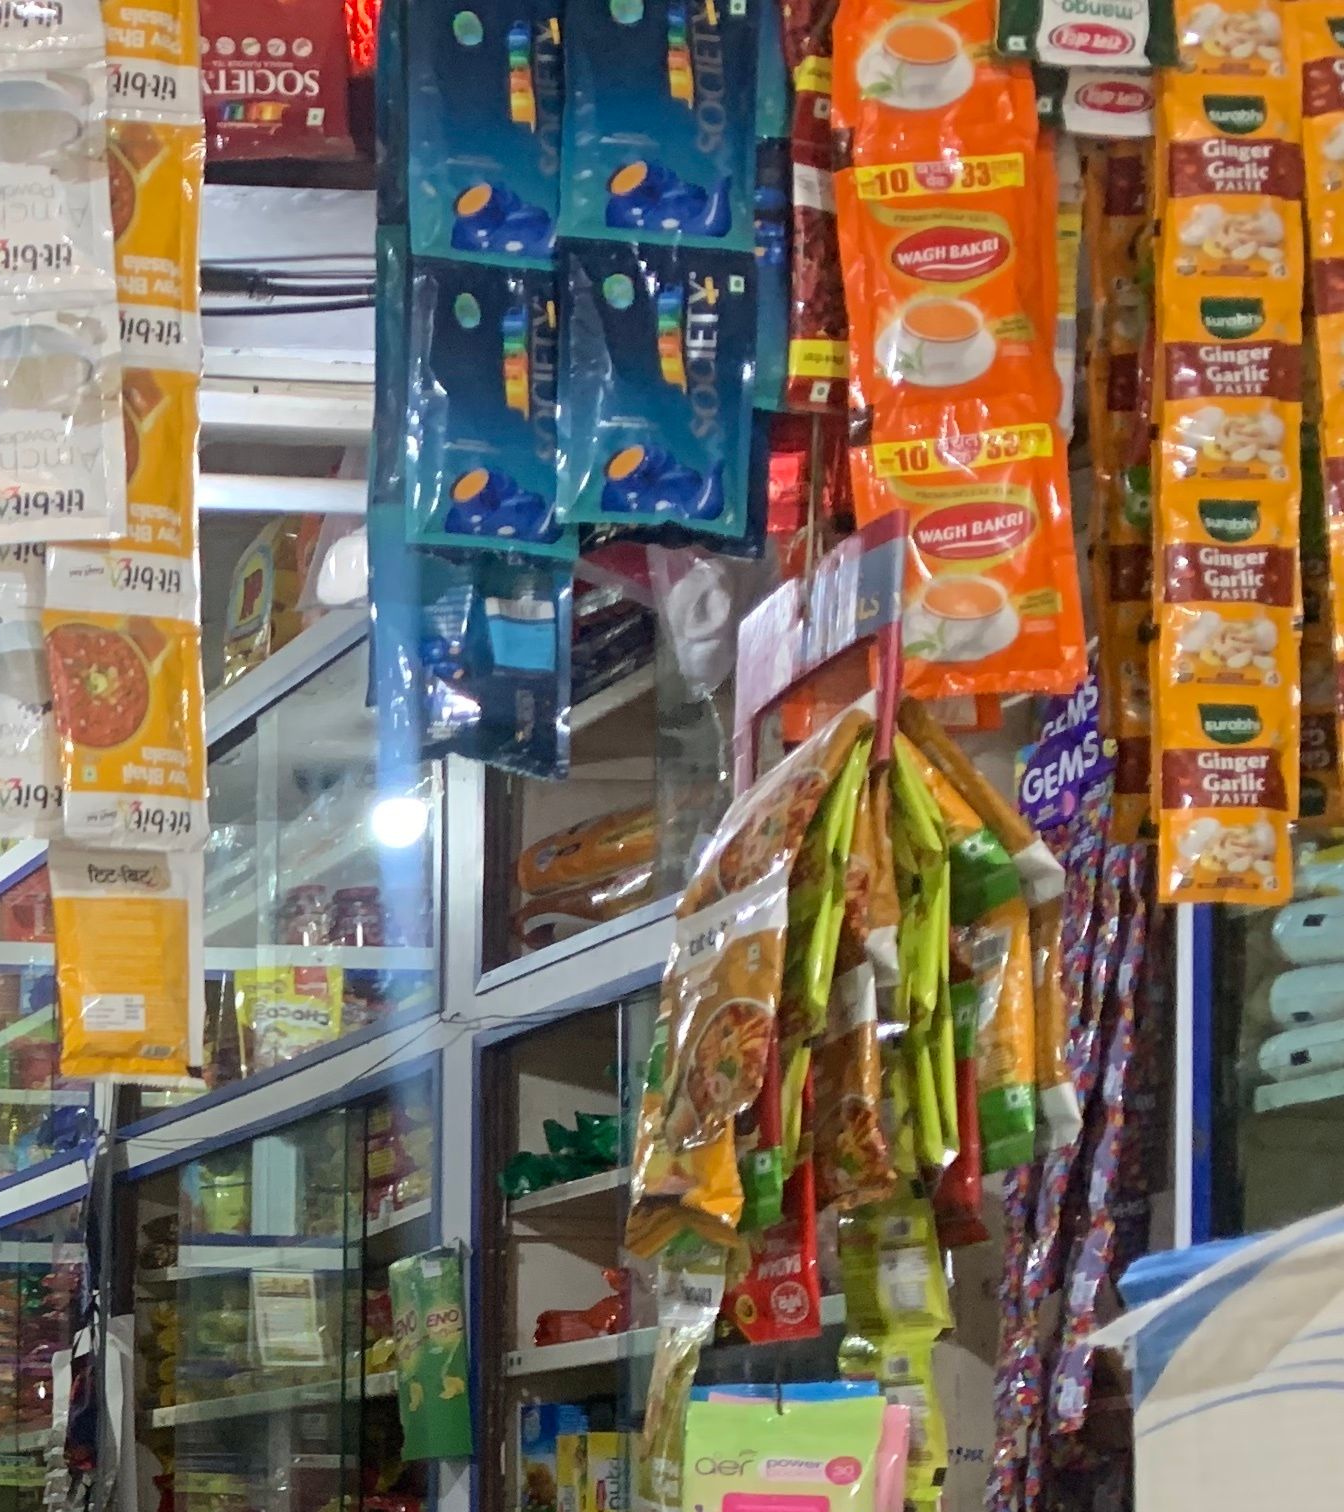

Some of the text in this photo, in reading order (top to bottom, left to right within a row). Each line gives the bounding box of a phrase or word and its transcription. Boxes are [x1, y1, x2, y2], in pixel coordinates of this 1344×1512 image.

[1201, 138, 1271, 162] Ginger
[1205, 159, 1270, 182] Garlic
[1215, 180, 1262, 192] PASTE
[895, 236, 999, 266] WAGH BAKRI
[687, 278, 721, 440] SOCIETY
[1199, 343, 1272, 367] Ginger
[1205, 363, 1270, 386] Garlic
[1213, 382, 1264, 395] PASTE
[917, 510, 1024, 544] WAGH BAKRI
[1199, 546, 1269, 571] Ginger
[1204, 568, 1264, 590] Garlic
[1211, 586, 1258, 601] PASTE
[1021, 729, 1100, 804] GEMS
[1197, 751, 1270, 775] Ginger
[1202, 772, 1266, 793] Garlic
[1211, 791, 1259, 806] PASTE
[425, 1308, 460, 1331] ENO
[766, 1458, 824, 1471] power
